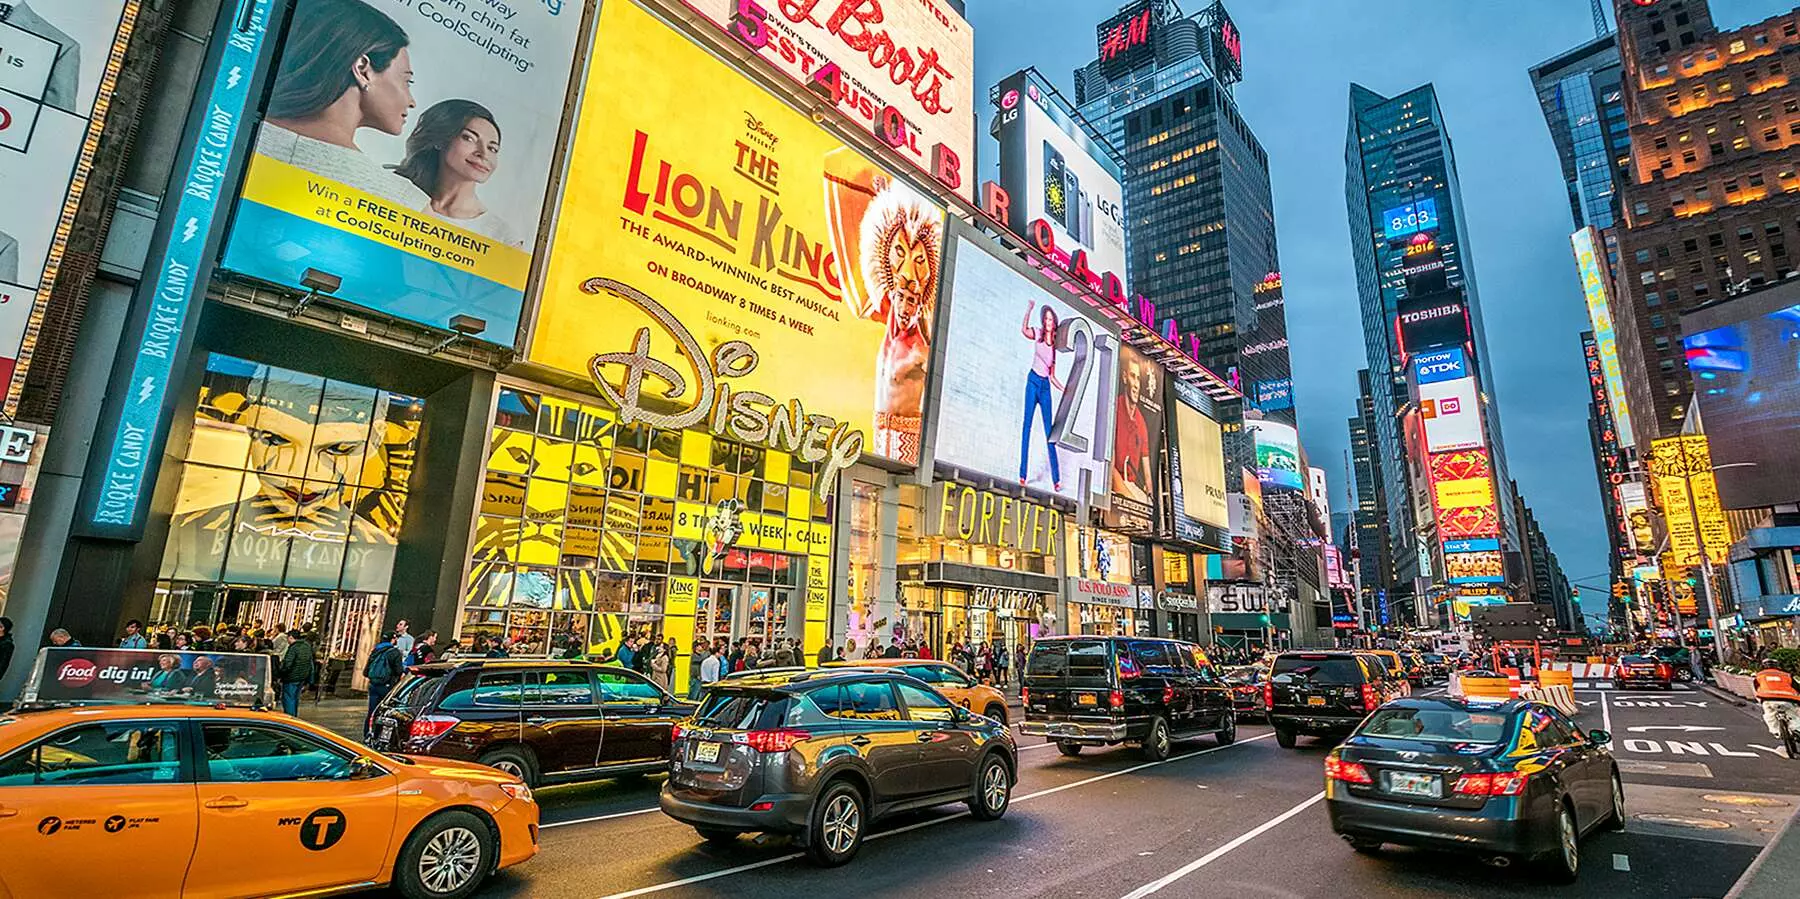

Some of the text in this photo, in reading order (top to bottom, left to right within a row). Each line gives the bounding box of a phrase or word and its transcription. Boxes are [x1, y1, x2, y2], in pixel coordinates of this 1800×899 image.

[471, 9, 505, 34] chin
[509, 29, 531, 50] fat
[1102, 9, 1150, 62] H&M
[1222, 20, 1241, 66] H&M
[7, 55, 24, 68] IS
[764, 22, 815, 75] EST
[1003, 110, 1018, 125] LG
[185, 104, 234, 202] BROOKE CANDY
[734, 139, 780, 188] THE
[307, 180, 491, 256] Win a FREE TREATMENT
[1096, 194, 1110, 216] LG
[1392, 210, 1429, 231] 8:03
[315, 205, 476, 268] at CoolSculpting.com
[1407, 240, 1435, 256] 2016
[620, 216, 841, 322] THE AWARD-WINNING BEST MUSICAL
[1404, 260, 1444, 276] TOSHIBA
[142, 257, 189, 359] BROOKE CANDY
[647, 261, 815, 337] ON BROADWAY 8 TIMES A WEEK
[705, 311, 761, 340] lionking.com
[1402, 304, 1461, 324] TOSHIBA
[1601, 339, 1629, 417] GELA
[1586, 345, 1608, 416] ERNST
[1602, 430, 1615, 442] &
[116, 422, 146, 468] CANDY
[678, 512, 687, 526] 8
[750, 523, 784, 539] WEEK
[796, 530, 827, 544] CALL:
[938, 482, 1059, 557] FOREVER
[211, 528, 298, 569] BROOKE
[669, 577, 694, 595] KING
[808, 576, 823, 588] LION
[811, 567, 822, 576] THE
[807, 590, 825, 604] KING
[974, 587, 1038, 611] FOREVER 21
[1078, 580, 1091, 593] U.S.
[1093, 582, 1112, 596] POLO
[58, 664, 97, 682] food
[99, 666, 154, 684] dig in!
[1612, 701, 1709, 709] ONLY
[1623, 739, 1790, 760] ONLY
[278, 817, 302, 826] NYC
[312, 815, 339, 846] T
